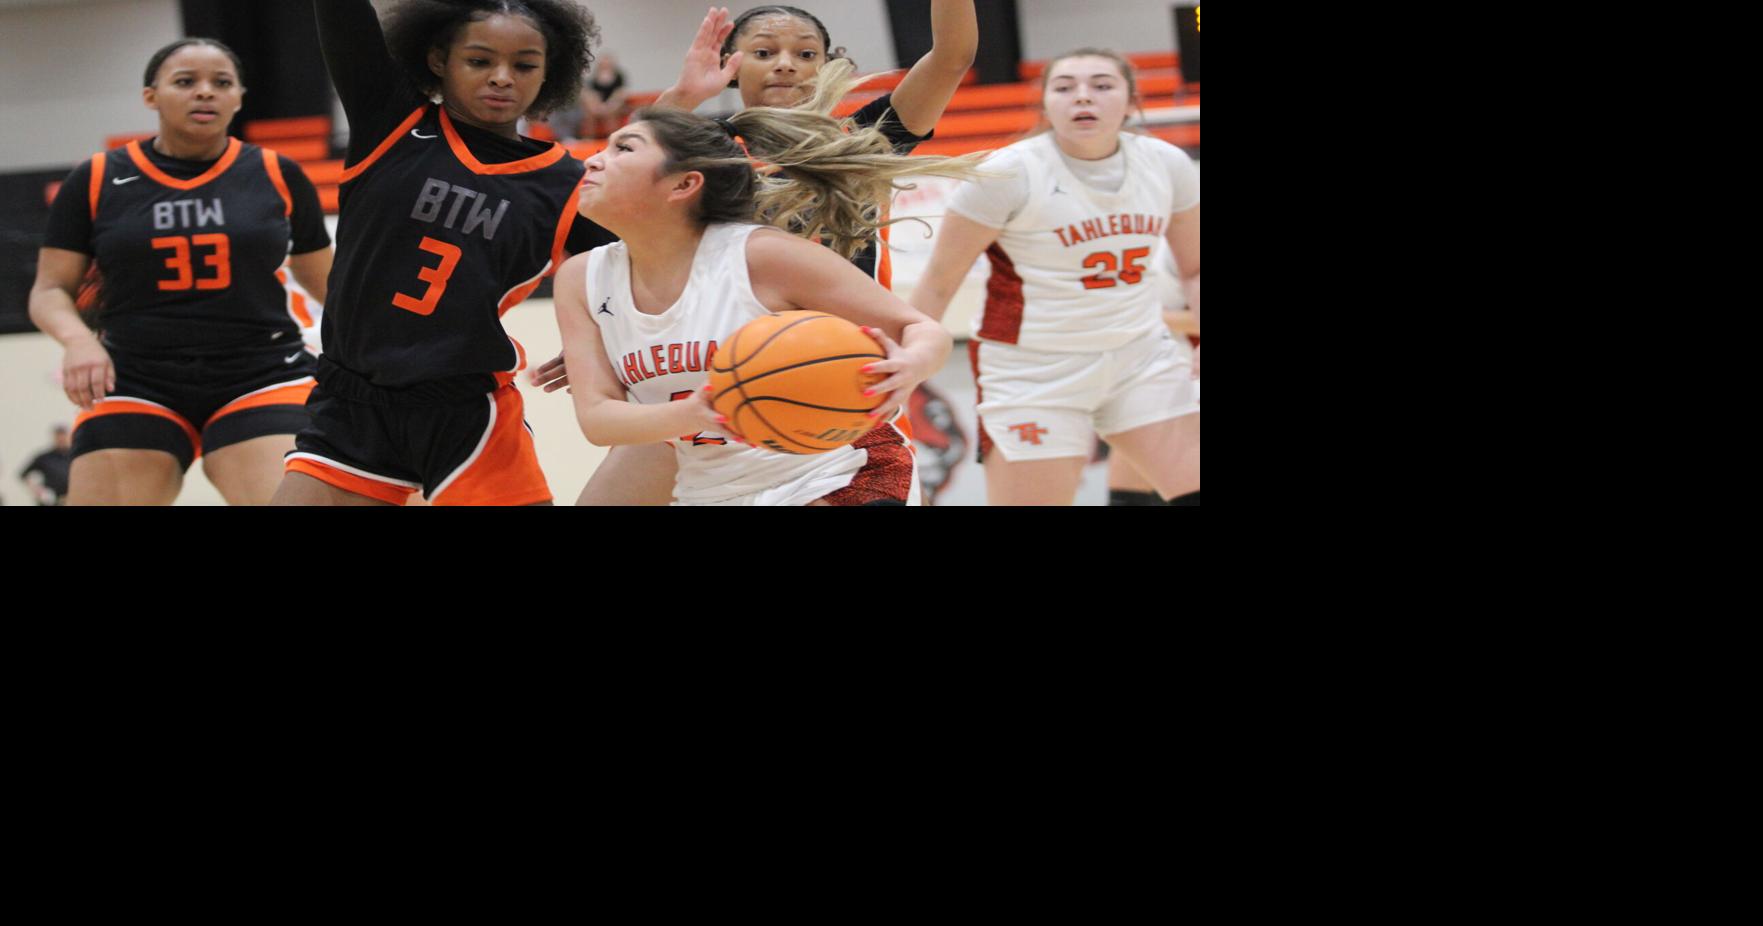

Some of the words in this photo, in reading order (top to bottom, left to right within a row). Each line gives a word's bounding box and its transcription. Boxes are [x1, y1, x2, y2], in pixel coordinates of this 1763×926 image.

[153, 198, 224, 230] BTW
[410, 177, 511, 240] BTW
[151, 233, 231, 290] 33
[391, 236, 462, 316] 3
[1080, 246, 1150, 290] 25
[616, 340, 719, 386] HLEQUA
